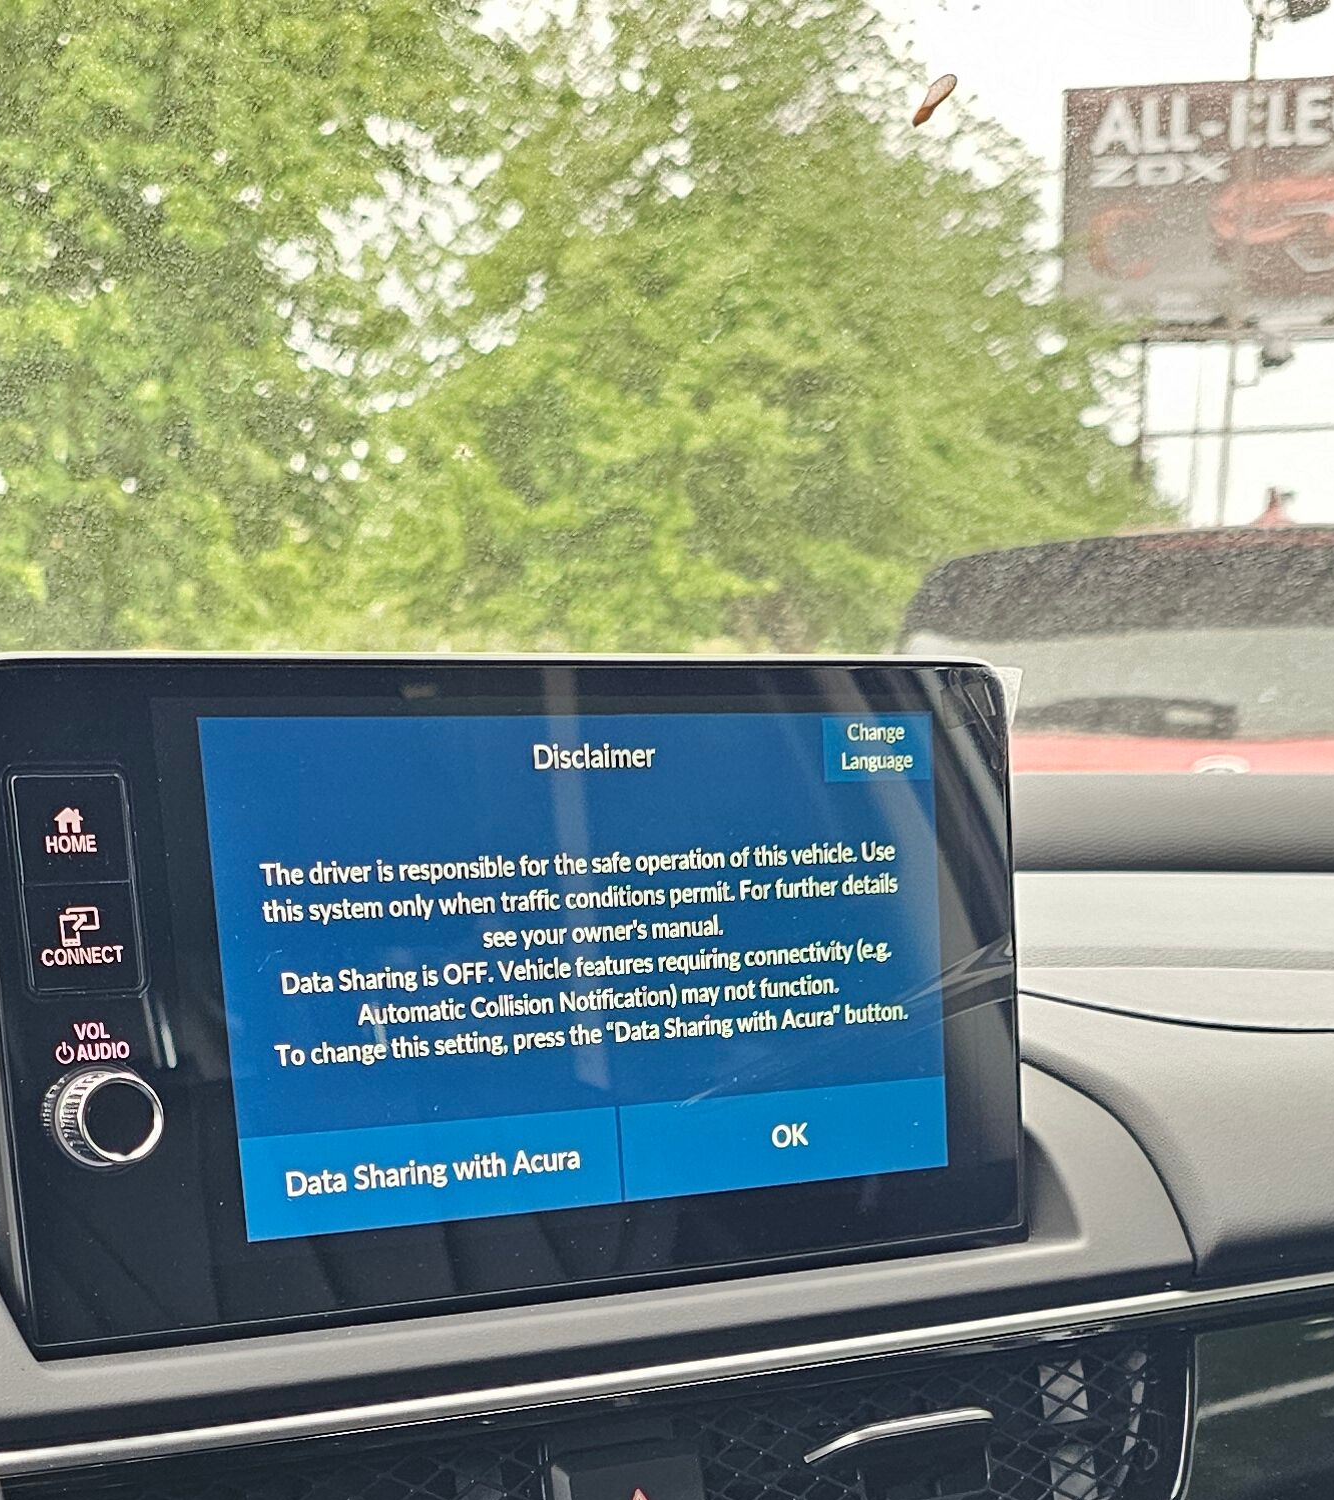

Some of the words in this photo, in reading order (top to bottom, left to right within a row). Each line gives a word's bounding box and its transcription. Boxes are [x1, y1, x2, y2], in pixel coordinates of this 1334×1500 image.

[847, 723, 906, 744] Change
[533, 743, 656, 771] Disclaimer
[841, 751, 914, 773] Language
[45, 835, 97, 854] HOME
[259, 862, 304, 886] The
[308, 861, 371, 884] driver
[376, 859, 394, 882] is
[399, 855, 515, 884] responsible
[519, 855, 549, 877] for
[554, 852, 588, 876] the
[592, 852, 631, 875] safe
[635, 848, 725, 876] operation
[729, 846, 750, 868] of
[753, 844, 788, 867] this
[791, 842, 857, 865] vehicle.
[861, 841, 896, 862] Use
[262, 899, 304, 923] this
[308, 899, 384, 925] system
[389, 894, 434, 920] only
[438, 891, 495, 915] when
[500, 888, 561, 913] traffic
[565, 885, 665, 910] conditions
[670, 880, 735, 908] permit.
[739, 879, 771, 900] For
[775, 875, 838, 899] further
[842, 872, 899, 895] details
[483, 930, 517, 948] see
[521, 928, 567, 950] your
[572, 919, 648, 943] owner's
[652, 914, 723, 939] manual.
[40, 945, 124, 967] CONNECT
[281, 971, 334, 995] Data
[338, 967, 418, 992] Sharing
[422, 964, 439, 987] is
[443, 961, 494, 985] OFF.
[497, 956, 572, 982] Vehicle
[575, 955, 654, 978] features
[658, 948, 740, 975] requiring
[744, 940, 854, 967] connectivity
[857, 938, 892, 963] (e.g.
[357, 997, 466, 1026] Automatic
[470, 993, 554, 1018] Collision
[559, 983, 677, 1012] Notification)
[681, 985, 720, 1007] may
[724, 980, 756, 1001] not
[759, 974, 840, 998] function.
[73, 1022, 110, 1041] VOL
[274, 1044, 306, 1067] To
[310, 1041, 387, 1065] change
[391, 1035, 430, 1059] this
[434, 1031, 508, 1055] setting,
[513, 1031, 565, 1055] press
[569, 1024, 603, 1046] the
[664, 1014, 733, 1038] Sharing
[737, 1010, 777, 1033] with
[845, 1003, 909, 1025] button.
[76, 1042, 130, 1061] AUDIO
[771, 1122, 809, 1149] OK
[285, 1170, 347, 1197] Data
[353, 1160, 448, 1188] Sharing
[452, 1152, 507, 1181] with
[512, 1149, 581, 1176] Acura
